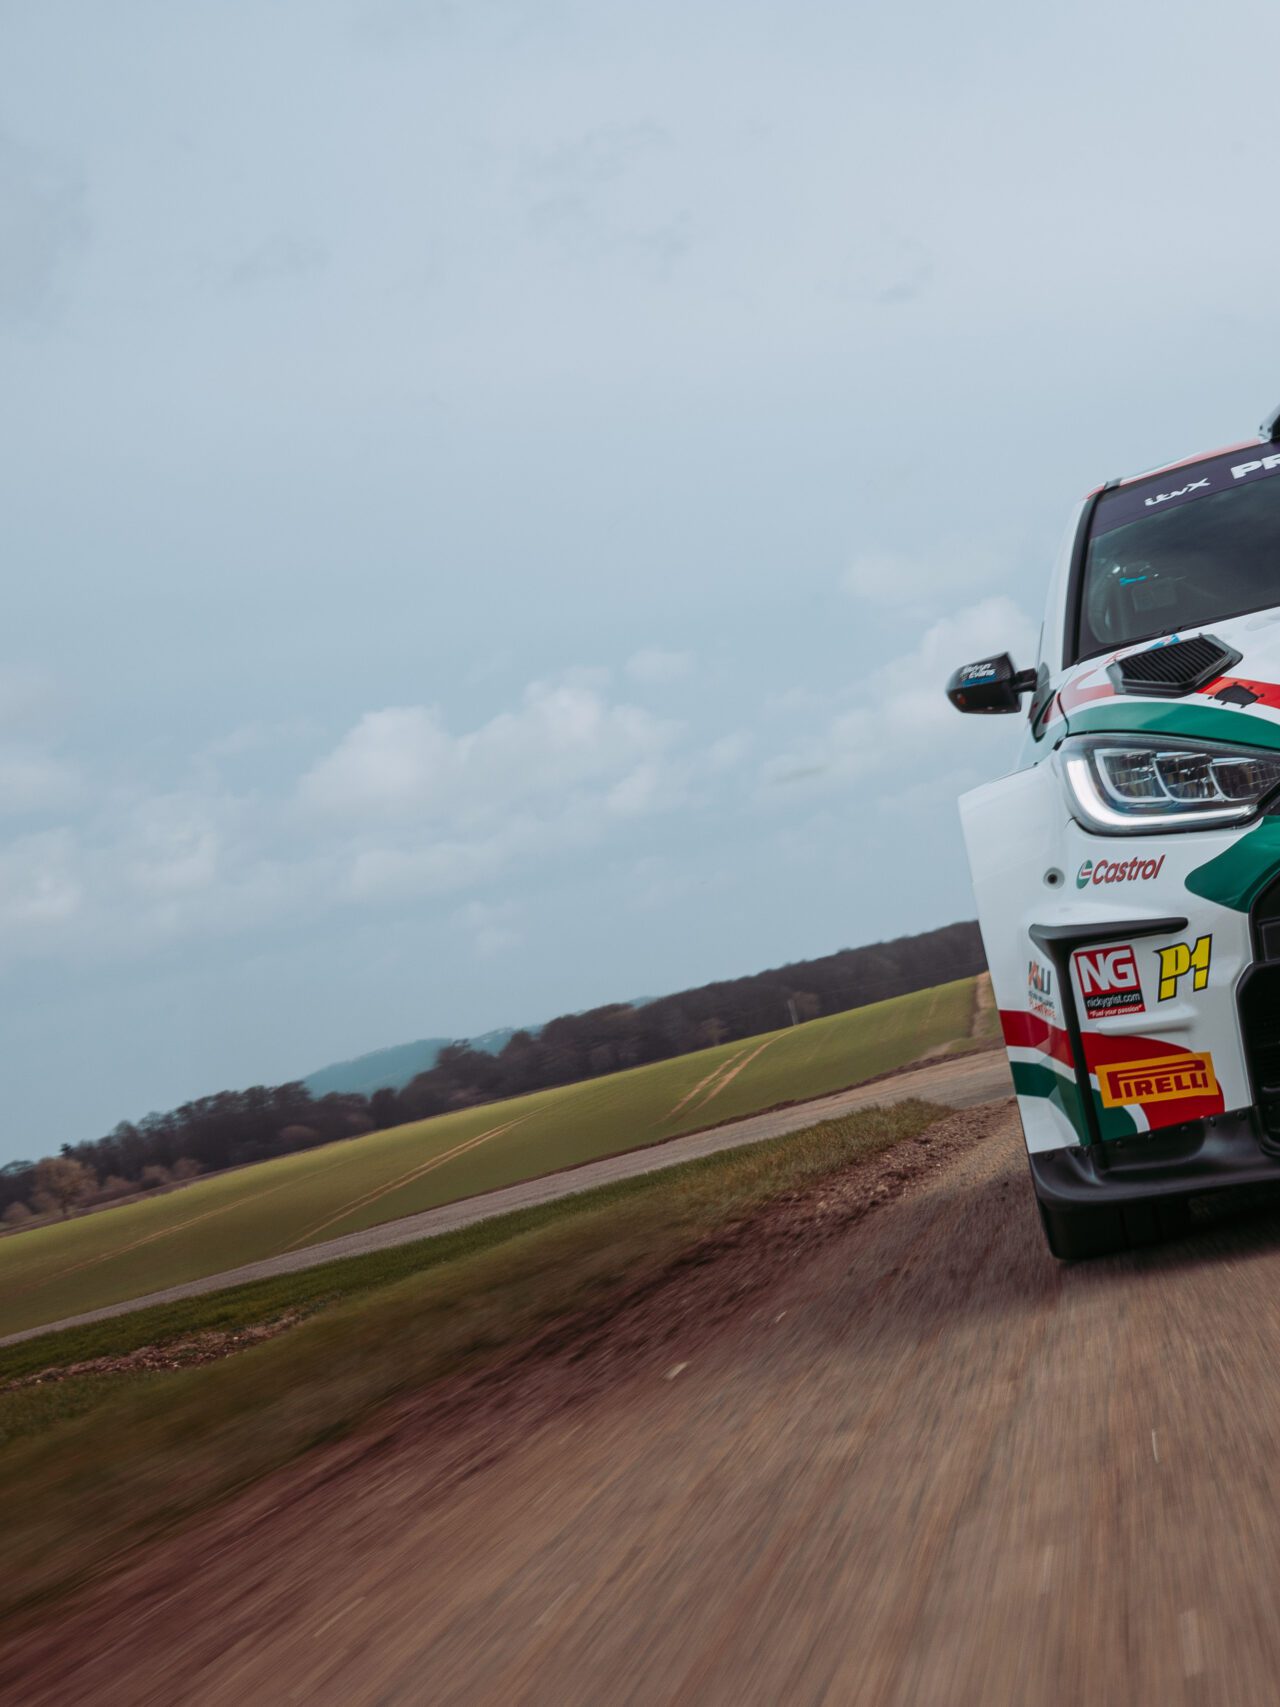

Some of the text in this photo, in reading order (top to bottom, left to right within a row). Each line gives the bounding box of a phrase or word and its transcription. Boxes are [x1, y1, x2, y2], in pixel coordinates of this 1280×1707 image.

[1091, 854, 1166, 886] Castrol
[1077, 949, 1137, 993] NG
[1150, 933, 1213, 1003] P1
[1106, 1058, 1209, 1101] PIRELLI
